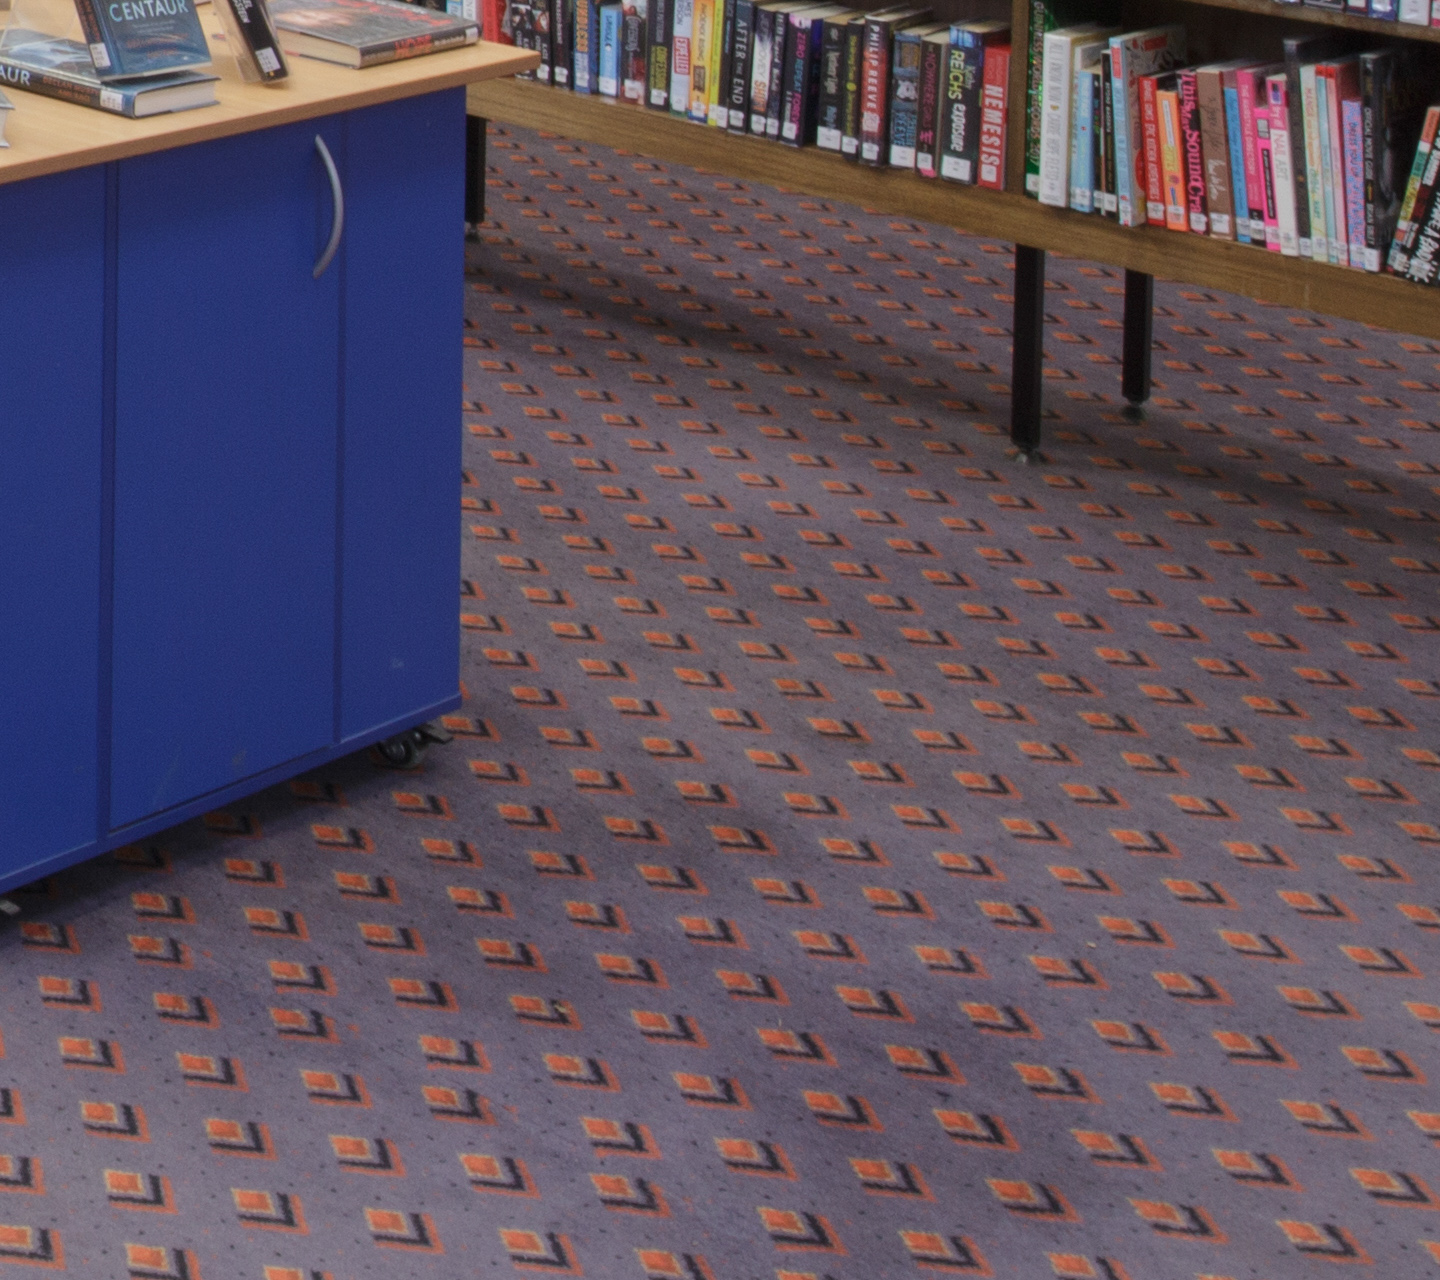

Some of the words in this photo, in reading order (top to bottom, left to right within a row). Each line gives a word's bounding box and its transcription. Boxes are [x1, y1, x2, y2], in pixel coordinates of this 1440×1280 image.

[735, 19, 748, 60] AFTER
[868, 25, 880, 66] PHILIP
[1033, 1, 1044, 52] GUINNESS
[732, 78, 744, 104] END
[867, 70, 878, 109] REEVE
[922, 53, 936, 104] NOWHERE
[948, 50, 965, 100] REICHS
[1031, 55, 1042, 94] WORLD
[1181, 73, 1198, 108] This
[951, 103, 966, 152] exposure
[981, 84, 1003, 166] NEMESIS
[1030, 95, 1041, 139] RECORDS
[1185, 130, 1203, 180] Sound
[1188, 180, 1205, 212] Cra
